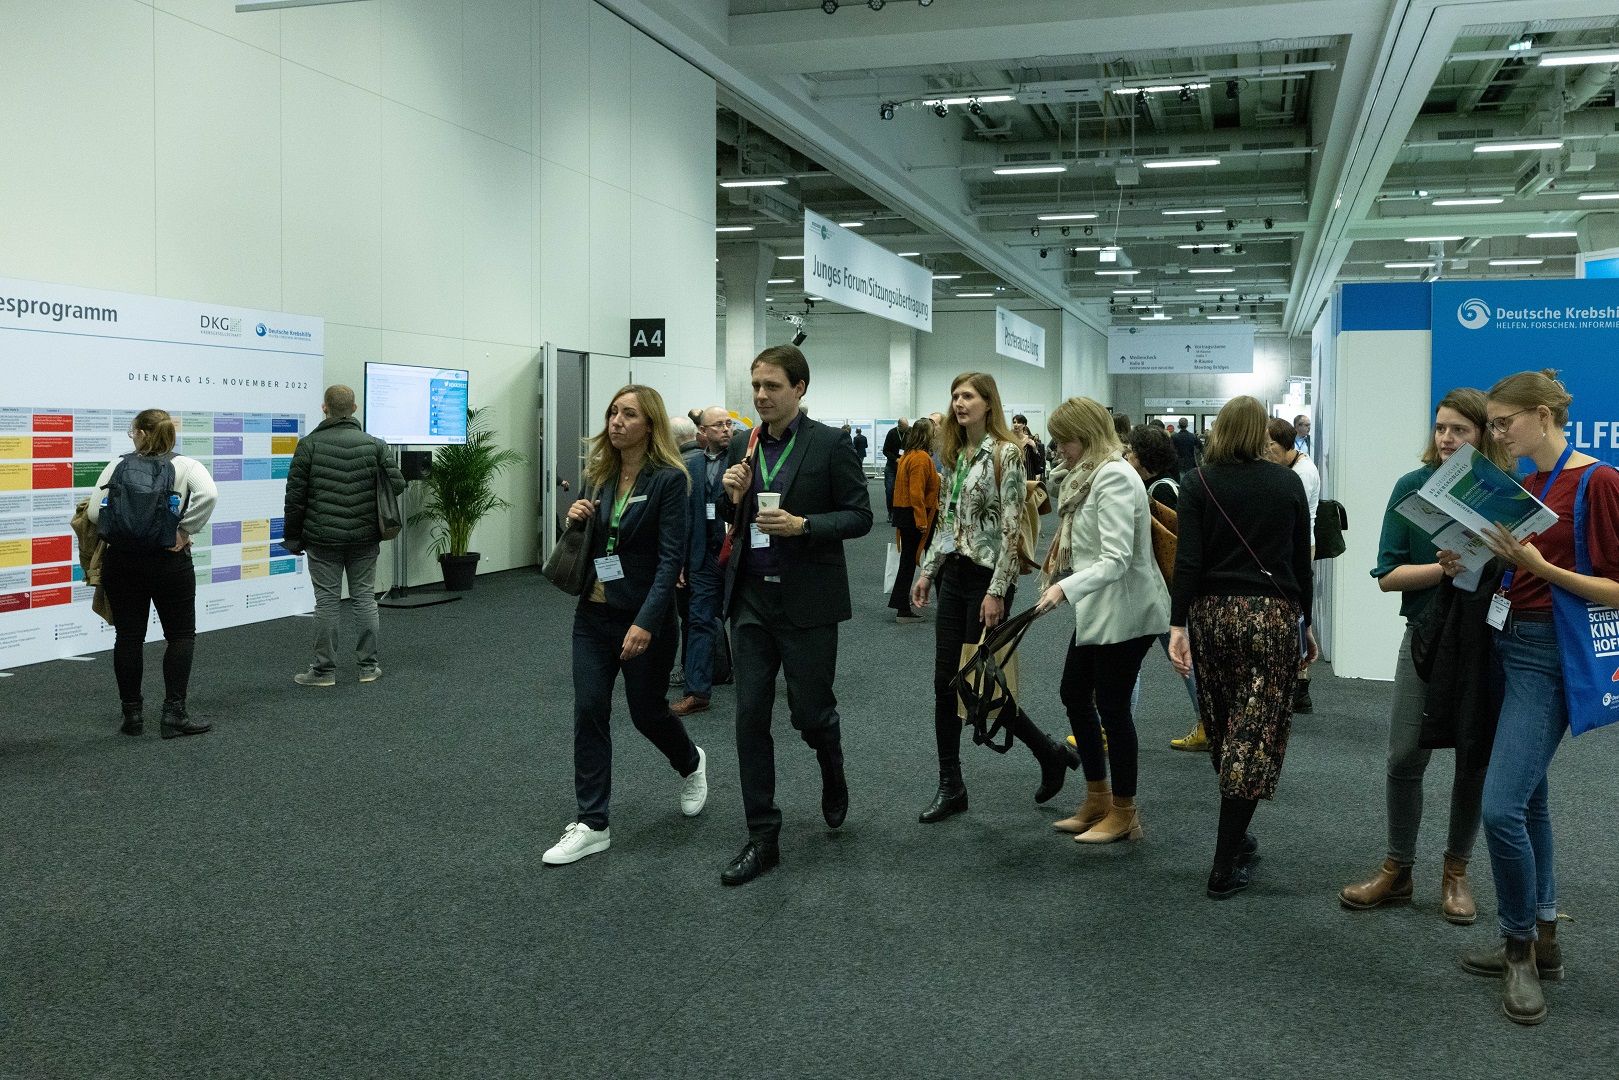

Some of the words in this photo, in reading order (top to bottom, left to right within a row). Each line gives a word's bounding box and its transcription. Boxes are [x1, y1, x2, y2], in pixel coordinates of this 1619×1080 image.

[813, 254, 841, 287] Junges
[1496, 307, 1561, 320] Deutsche
[200, 315, 229, 331] DKG
[1496, 321, 1529, 329] HELFEN.
[1531, 321, 1577, 329] FORSCHEN.
[633, 329, 663, 347] A4
[128, 372, 191, 384] DIENSTAG
[198, 376, 215, 385] 15.
[222, 378, 279, 388] NOVEMBER
[285, 381, 308, 390] 2022
[1563, 421, 1619, 449] LFE
[1588, 611, 1619, 623] SCHEN
[1590, 621, 1619, 638] KIN
[1593, 638, 1619, 652] HOF
